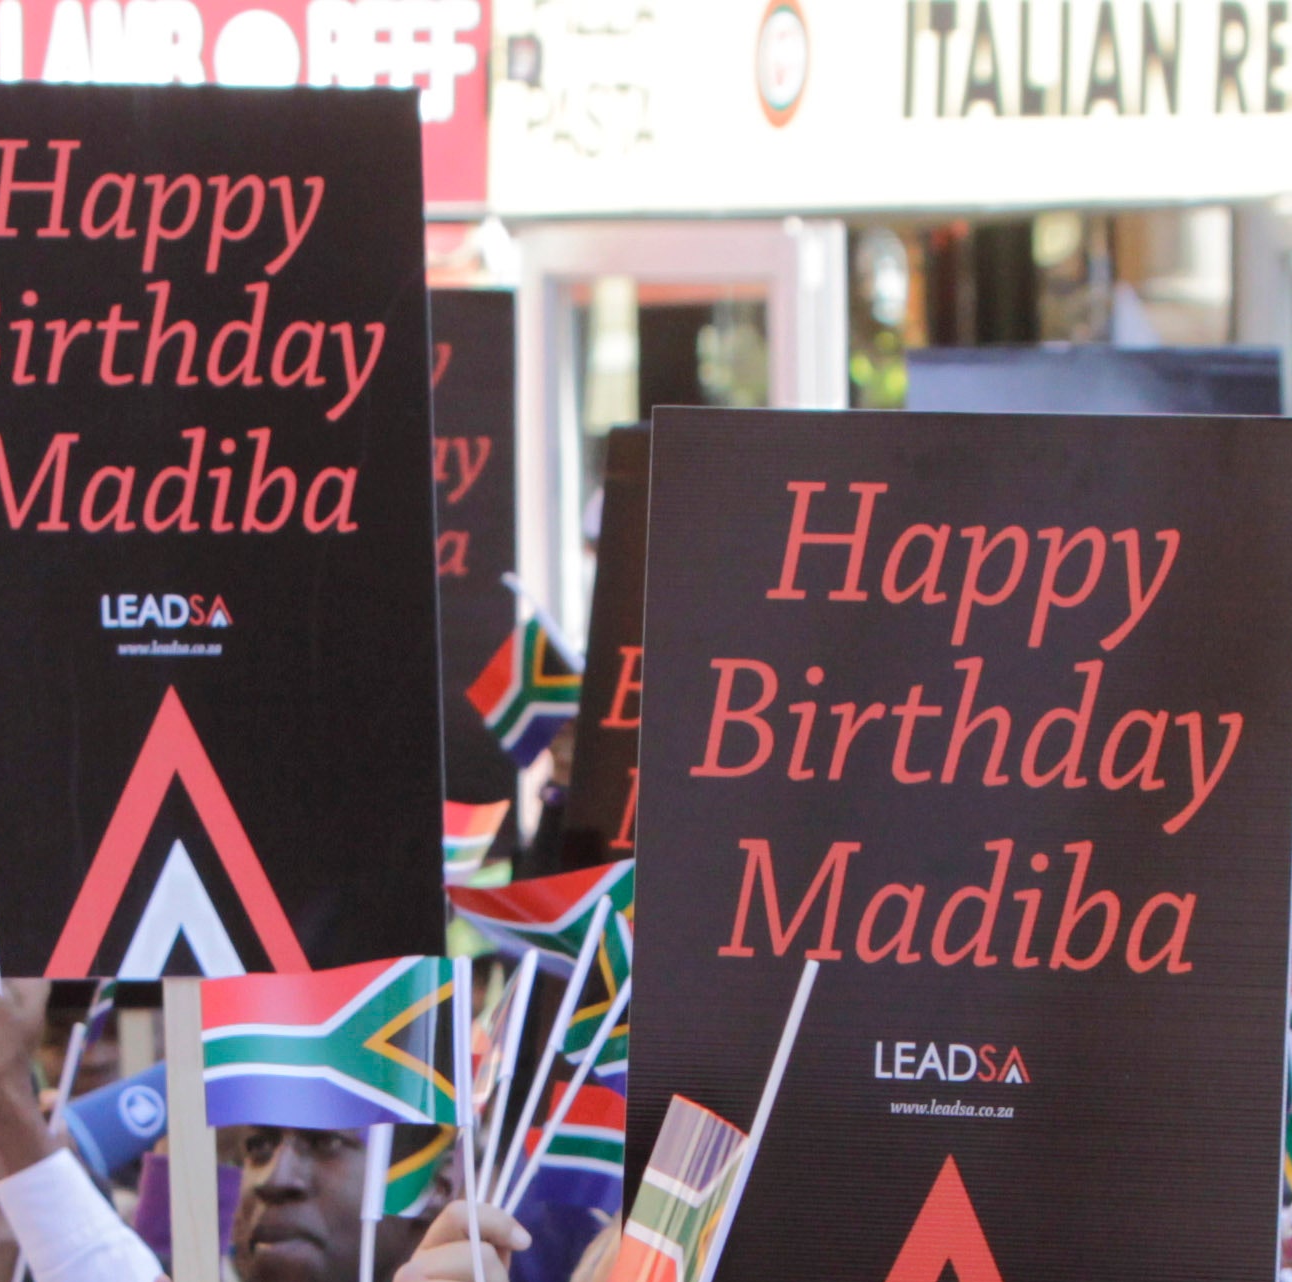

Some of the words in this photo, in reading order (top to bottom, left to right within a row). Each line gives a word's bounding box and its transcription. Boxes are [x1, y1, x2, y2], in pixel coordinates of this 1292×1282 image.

[903, 0, 1182, 118] ITALIAN
[101, 593, 234, 629] LEADSA
[766, 480, 1181, 650] Happy
[689, 656, 1244, 834] Birthday
[718, 838, 1197, 974] Madiba
[874, 1041, 1032, 1084] LEADSA
[890, 1099, 1015, 1119] www.leadsa.co.za
